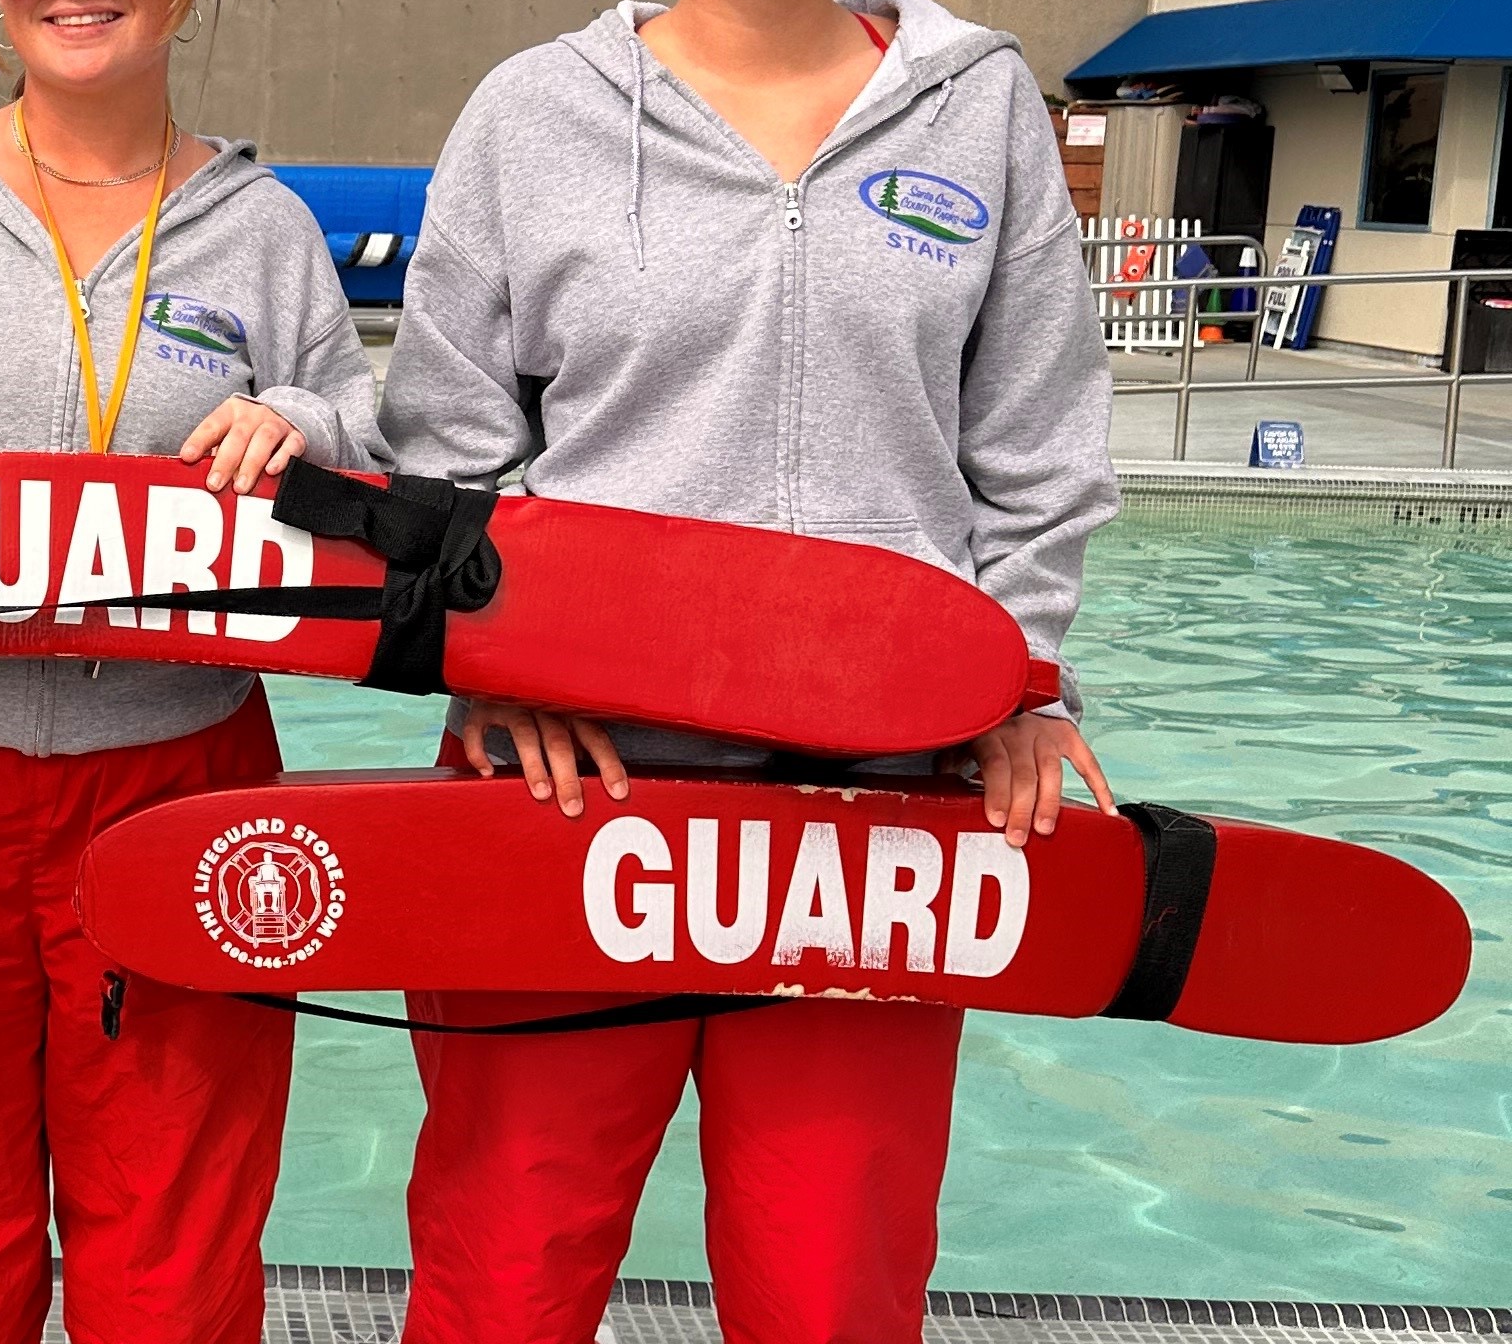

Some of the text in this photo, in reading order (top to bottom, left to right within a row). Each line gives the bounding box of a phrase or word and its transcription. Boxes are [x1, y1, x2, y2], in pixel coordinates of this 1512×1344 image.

[886, 232, 959, 269] STAFF
[1268, 291, 1287, 307] FULL
[155, 344, 230, 378] STAFF
[193, 817, 347, 941] THE LIFEGUARD STORE.COM
[582, 815, 1031, 978] GUARD
[220, 938, 324, 969] 800-846-7052
